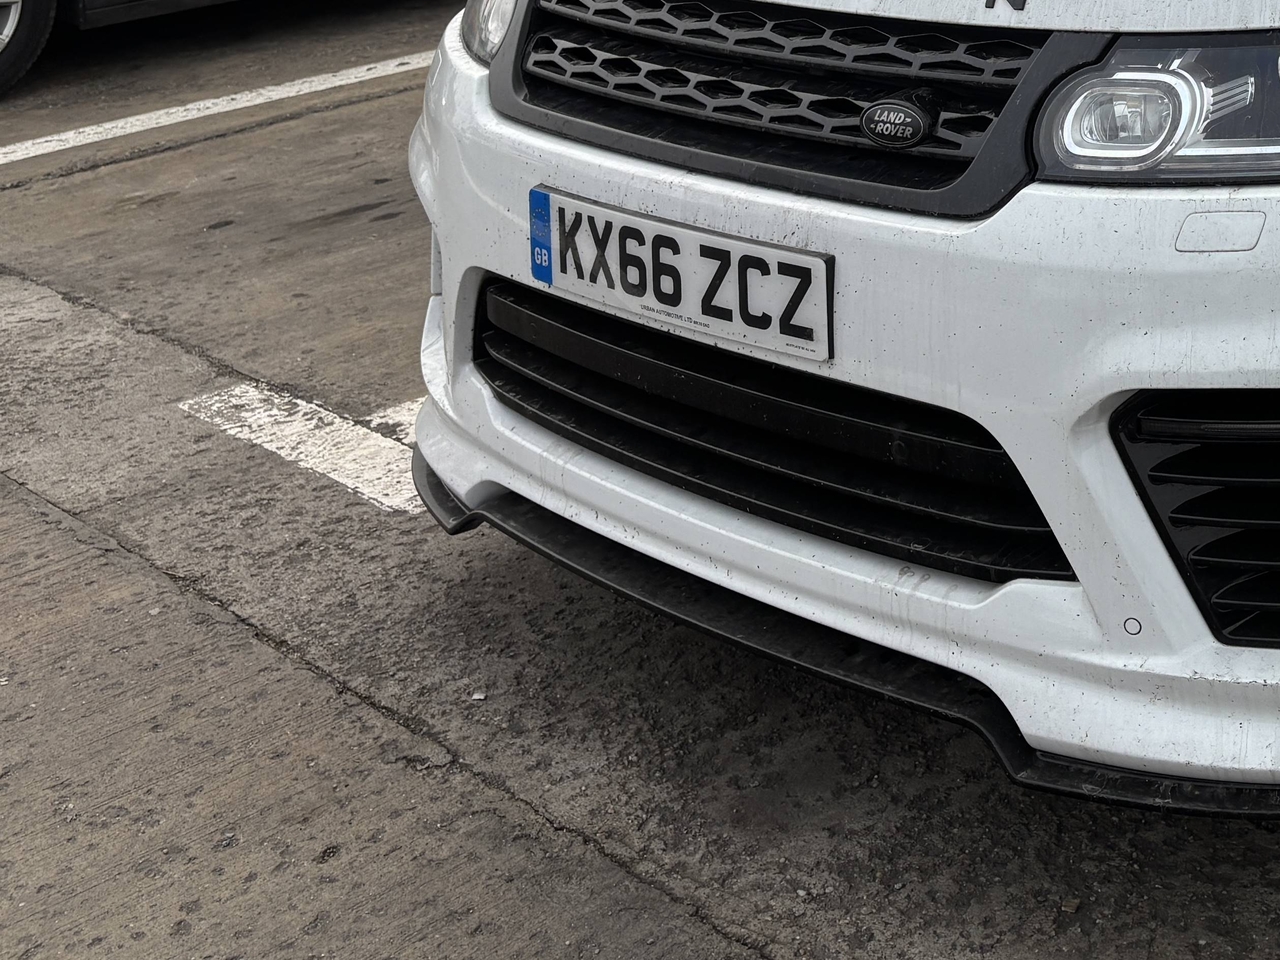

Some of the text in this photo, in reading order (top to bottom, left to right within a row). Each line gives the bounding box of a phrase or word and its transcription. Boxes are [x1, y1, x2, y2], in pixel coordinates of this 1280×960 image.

[874, 109, 905, 124] LAND
[875, 122, 913, 138] ROVER
[534, 246, 549, 268] GB
[557, 206, 815, 342] KX66 ZCZ
[640, 304, 655, 313] URBAN
[655, 308, 683, 321] AUTOMOTIVE
[684, 316, 693, 324] LTD
